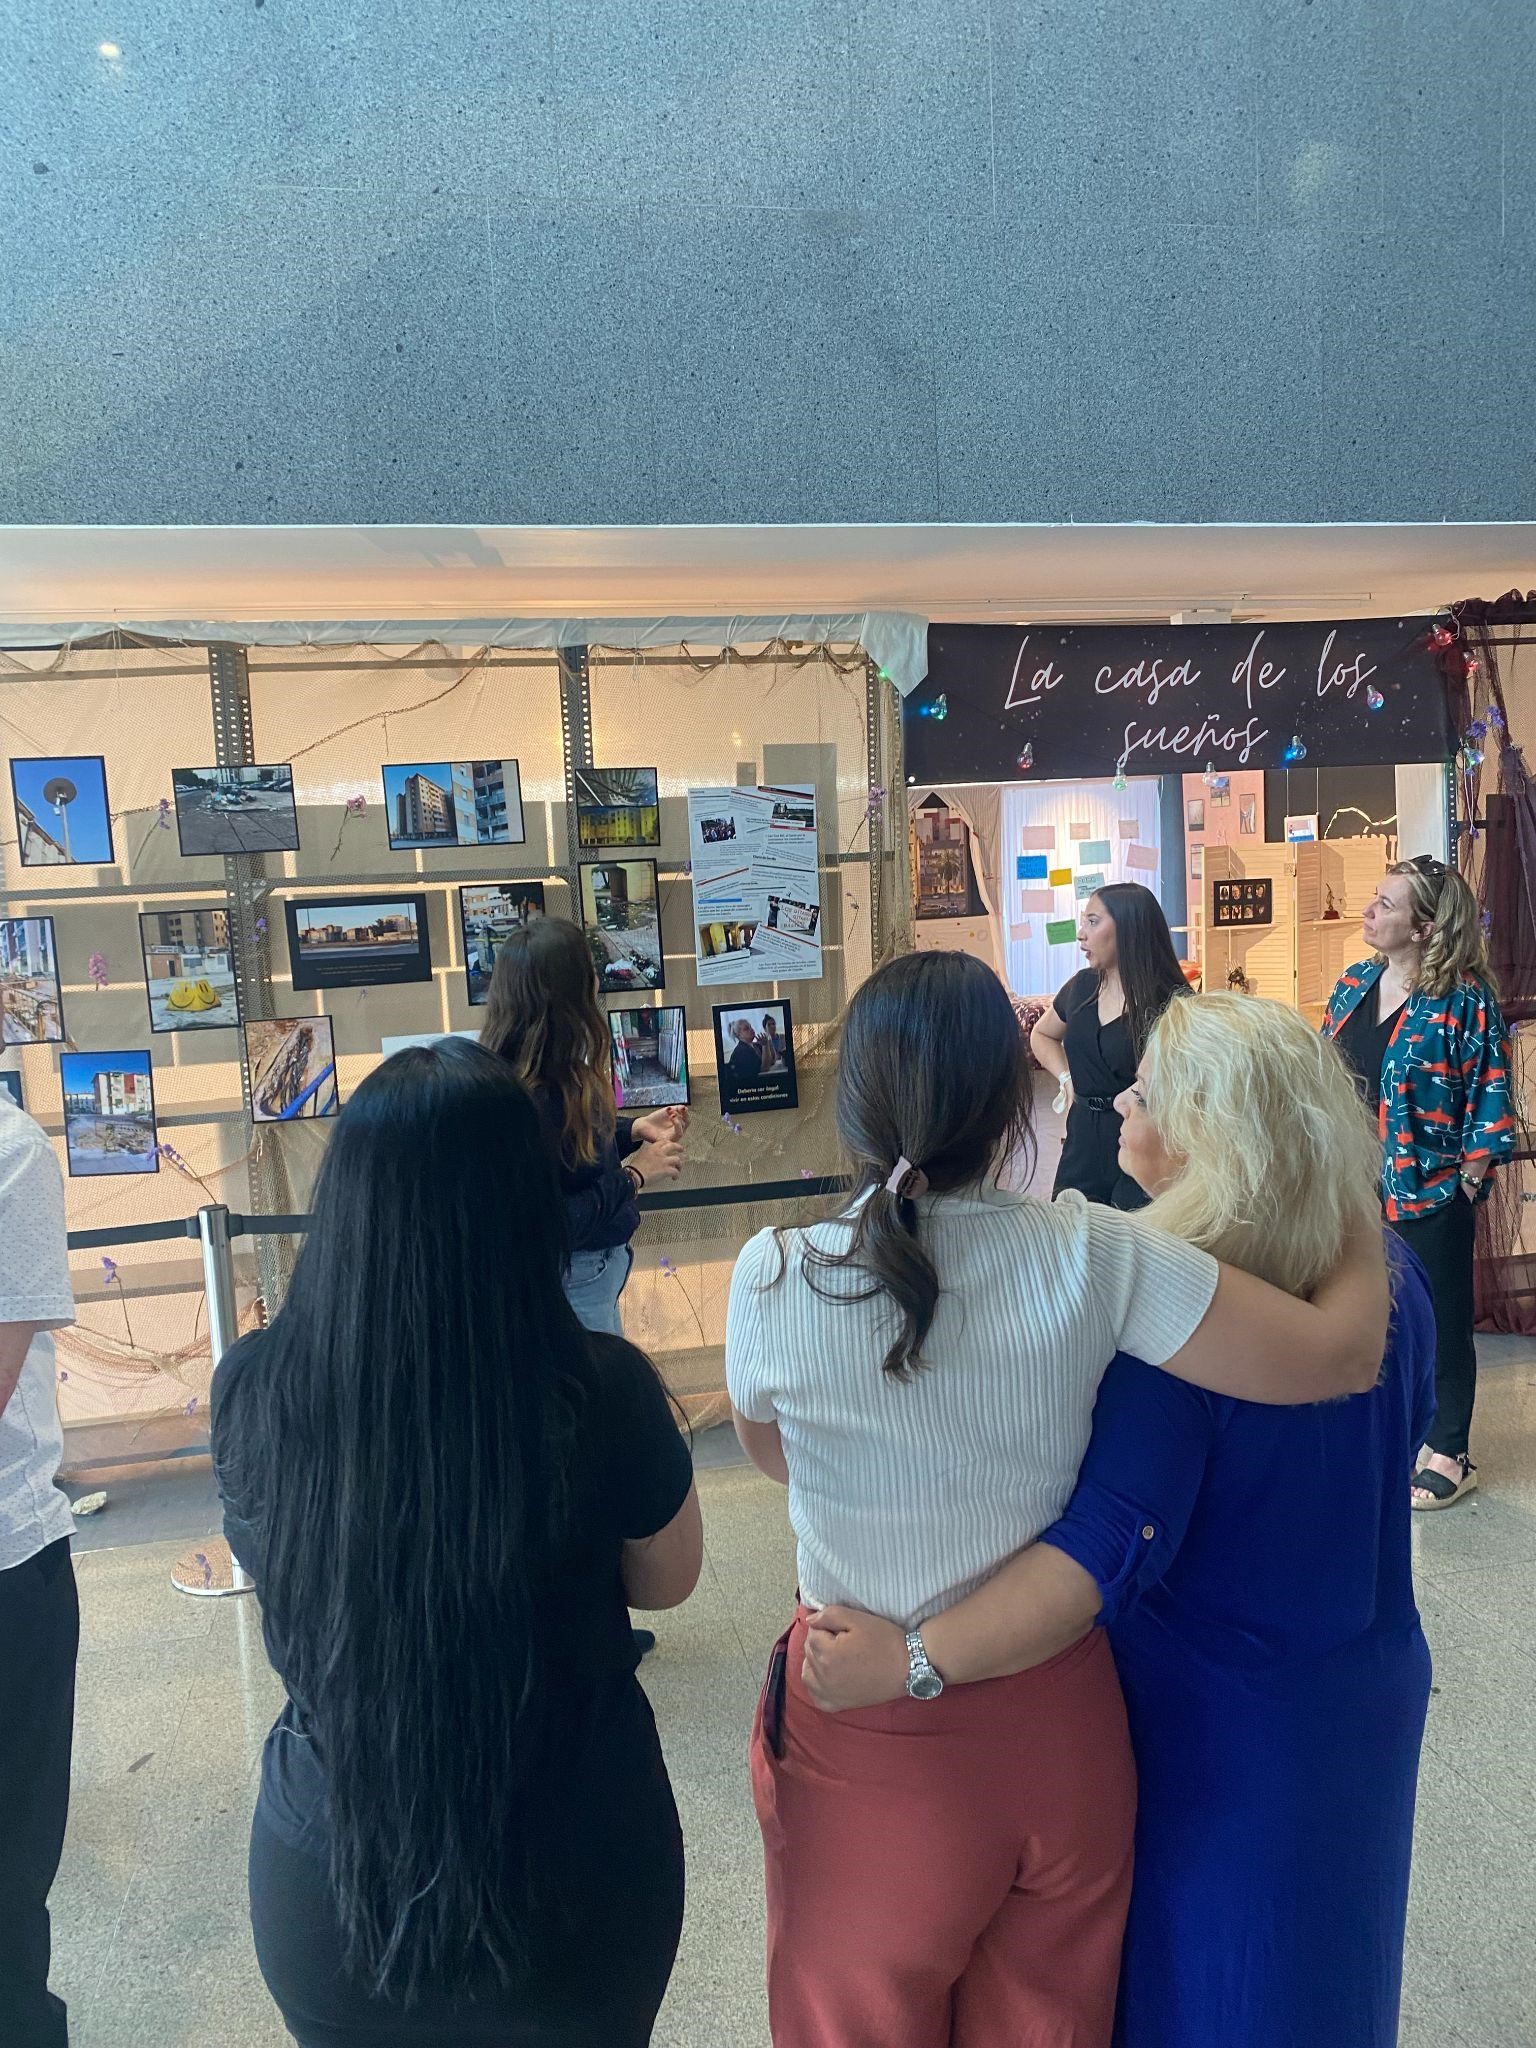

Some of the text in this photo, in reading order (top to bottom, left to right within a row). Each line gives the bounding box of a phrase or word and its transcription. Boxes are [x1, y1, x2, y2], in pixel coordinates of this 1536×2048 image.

[1004, 629, 1378, 710] La casa de los
[1115, 713, 1269, 768] sueños
